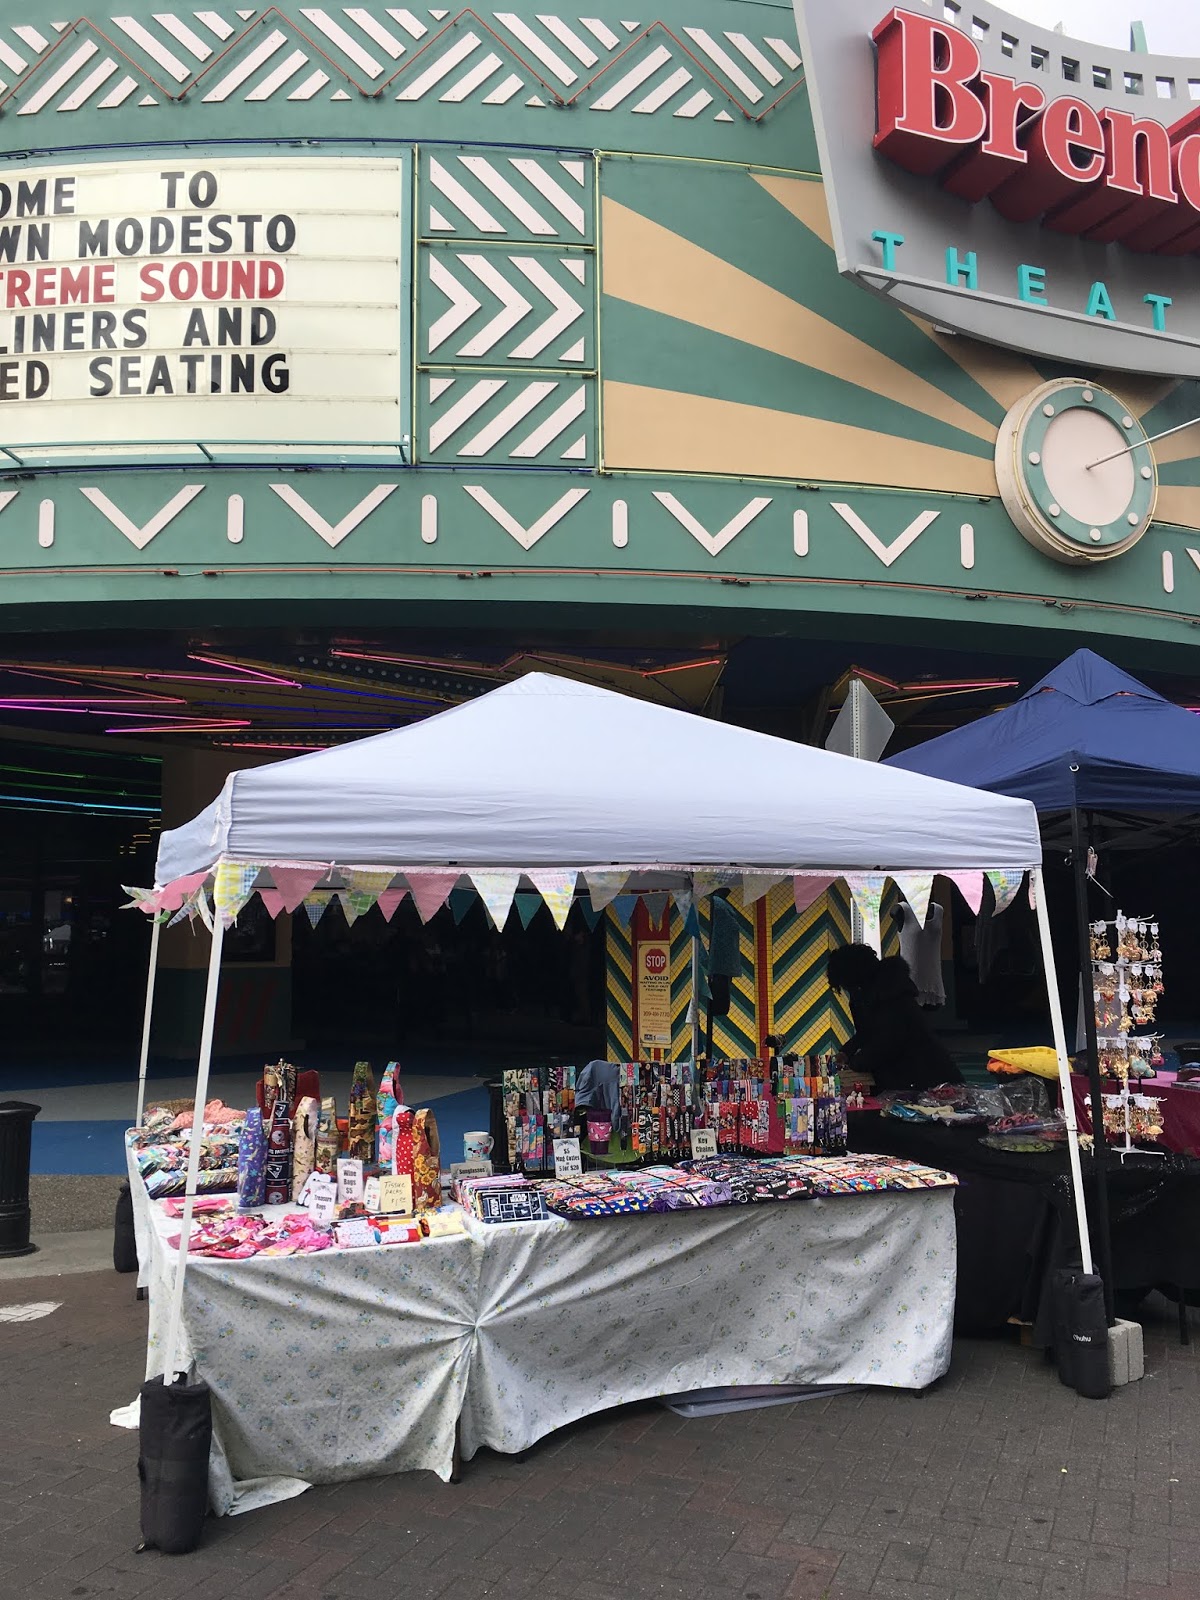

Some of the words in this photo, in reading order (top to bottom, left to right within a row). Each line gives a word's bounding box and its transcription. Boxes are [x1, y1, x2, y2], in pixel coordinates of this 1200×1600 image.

[160, 170, 218, 209] TO
[0, 223, 50, 263] WN
[78, 213, 296, 258] MODESTO
[0, 264, 115, 308] REME
[139, 260, 285, 302] SOUND
[871, 230, 1172, 332] THEAT
[182, 306, 277, 347] AND
[0, 360, 50, 400] ED
[89, 353, 290, 397] SEATING
[646, 955, 666, 968] STOP
[695, 1145, 715, 1153] Chains
[343, 1169, 357, 1177] Wine
[343, 1178, 357, 1186] Bags
[314, 1194, 332, 1203] Treasure
